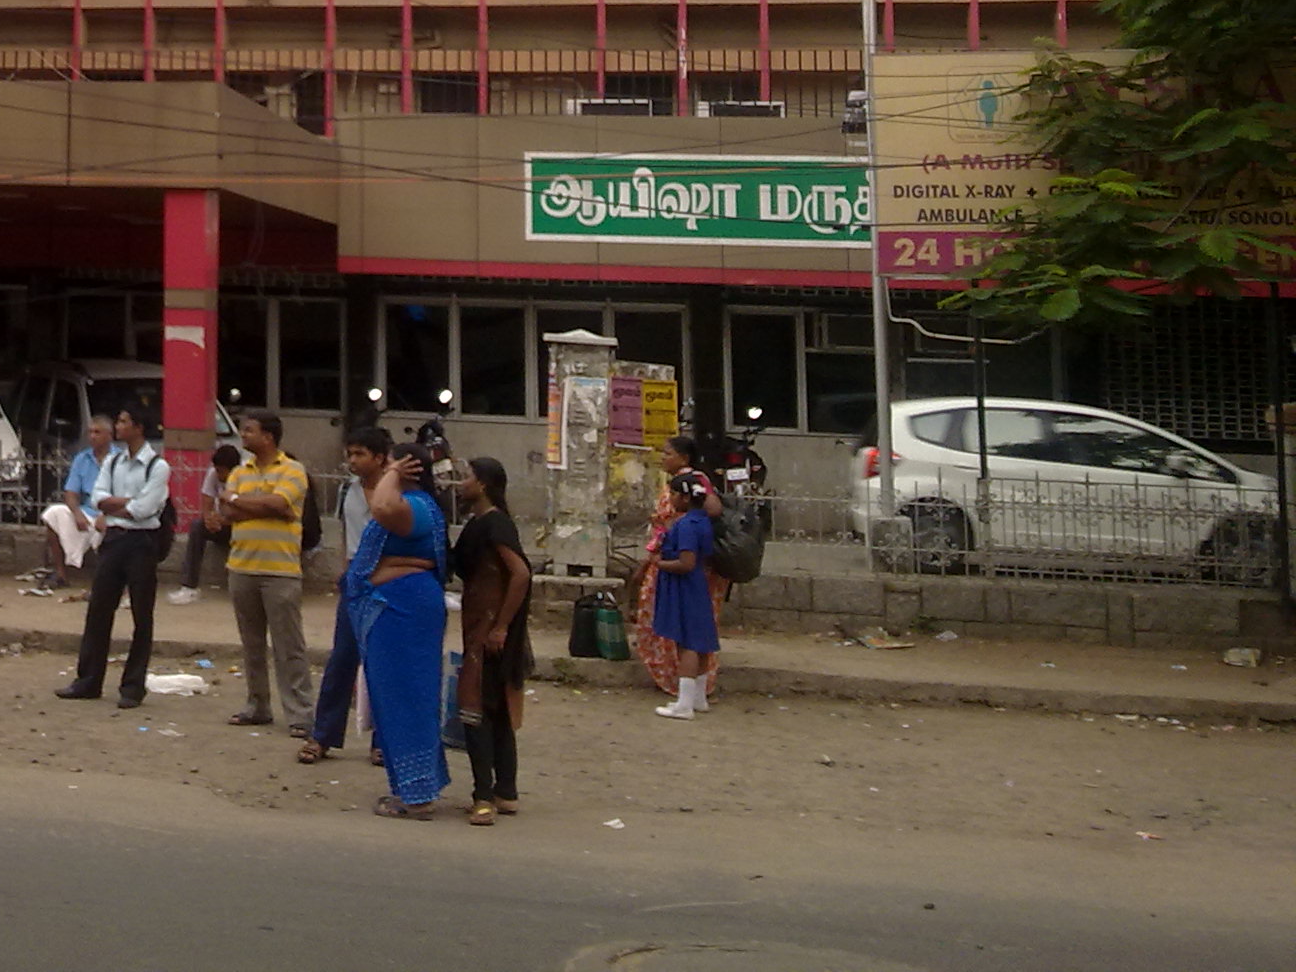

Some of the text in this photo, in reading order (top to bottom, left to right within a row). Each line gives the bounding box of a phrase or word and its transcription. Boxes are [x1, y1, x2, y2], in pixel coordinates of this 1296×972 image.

[540, 167, 742, 231] ஆயிஷா
[893, 185, 1015, 198] DIGITAL X-RAY
[1228, 211, 1296, 225] SONOL
[894, 237, 940, 266] 24
